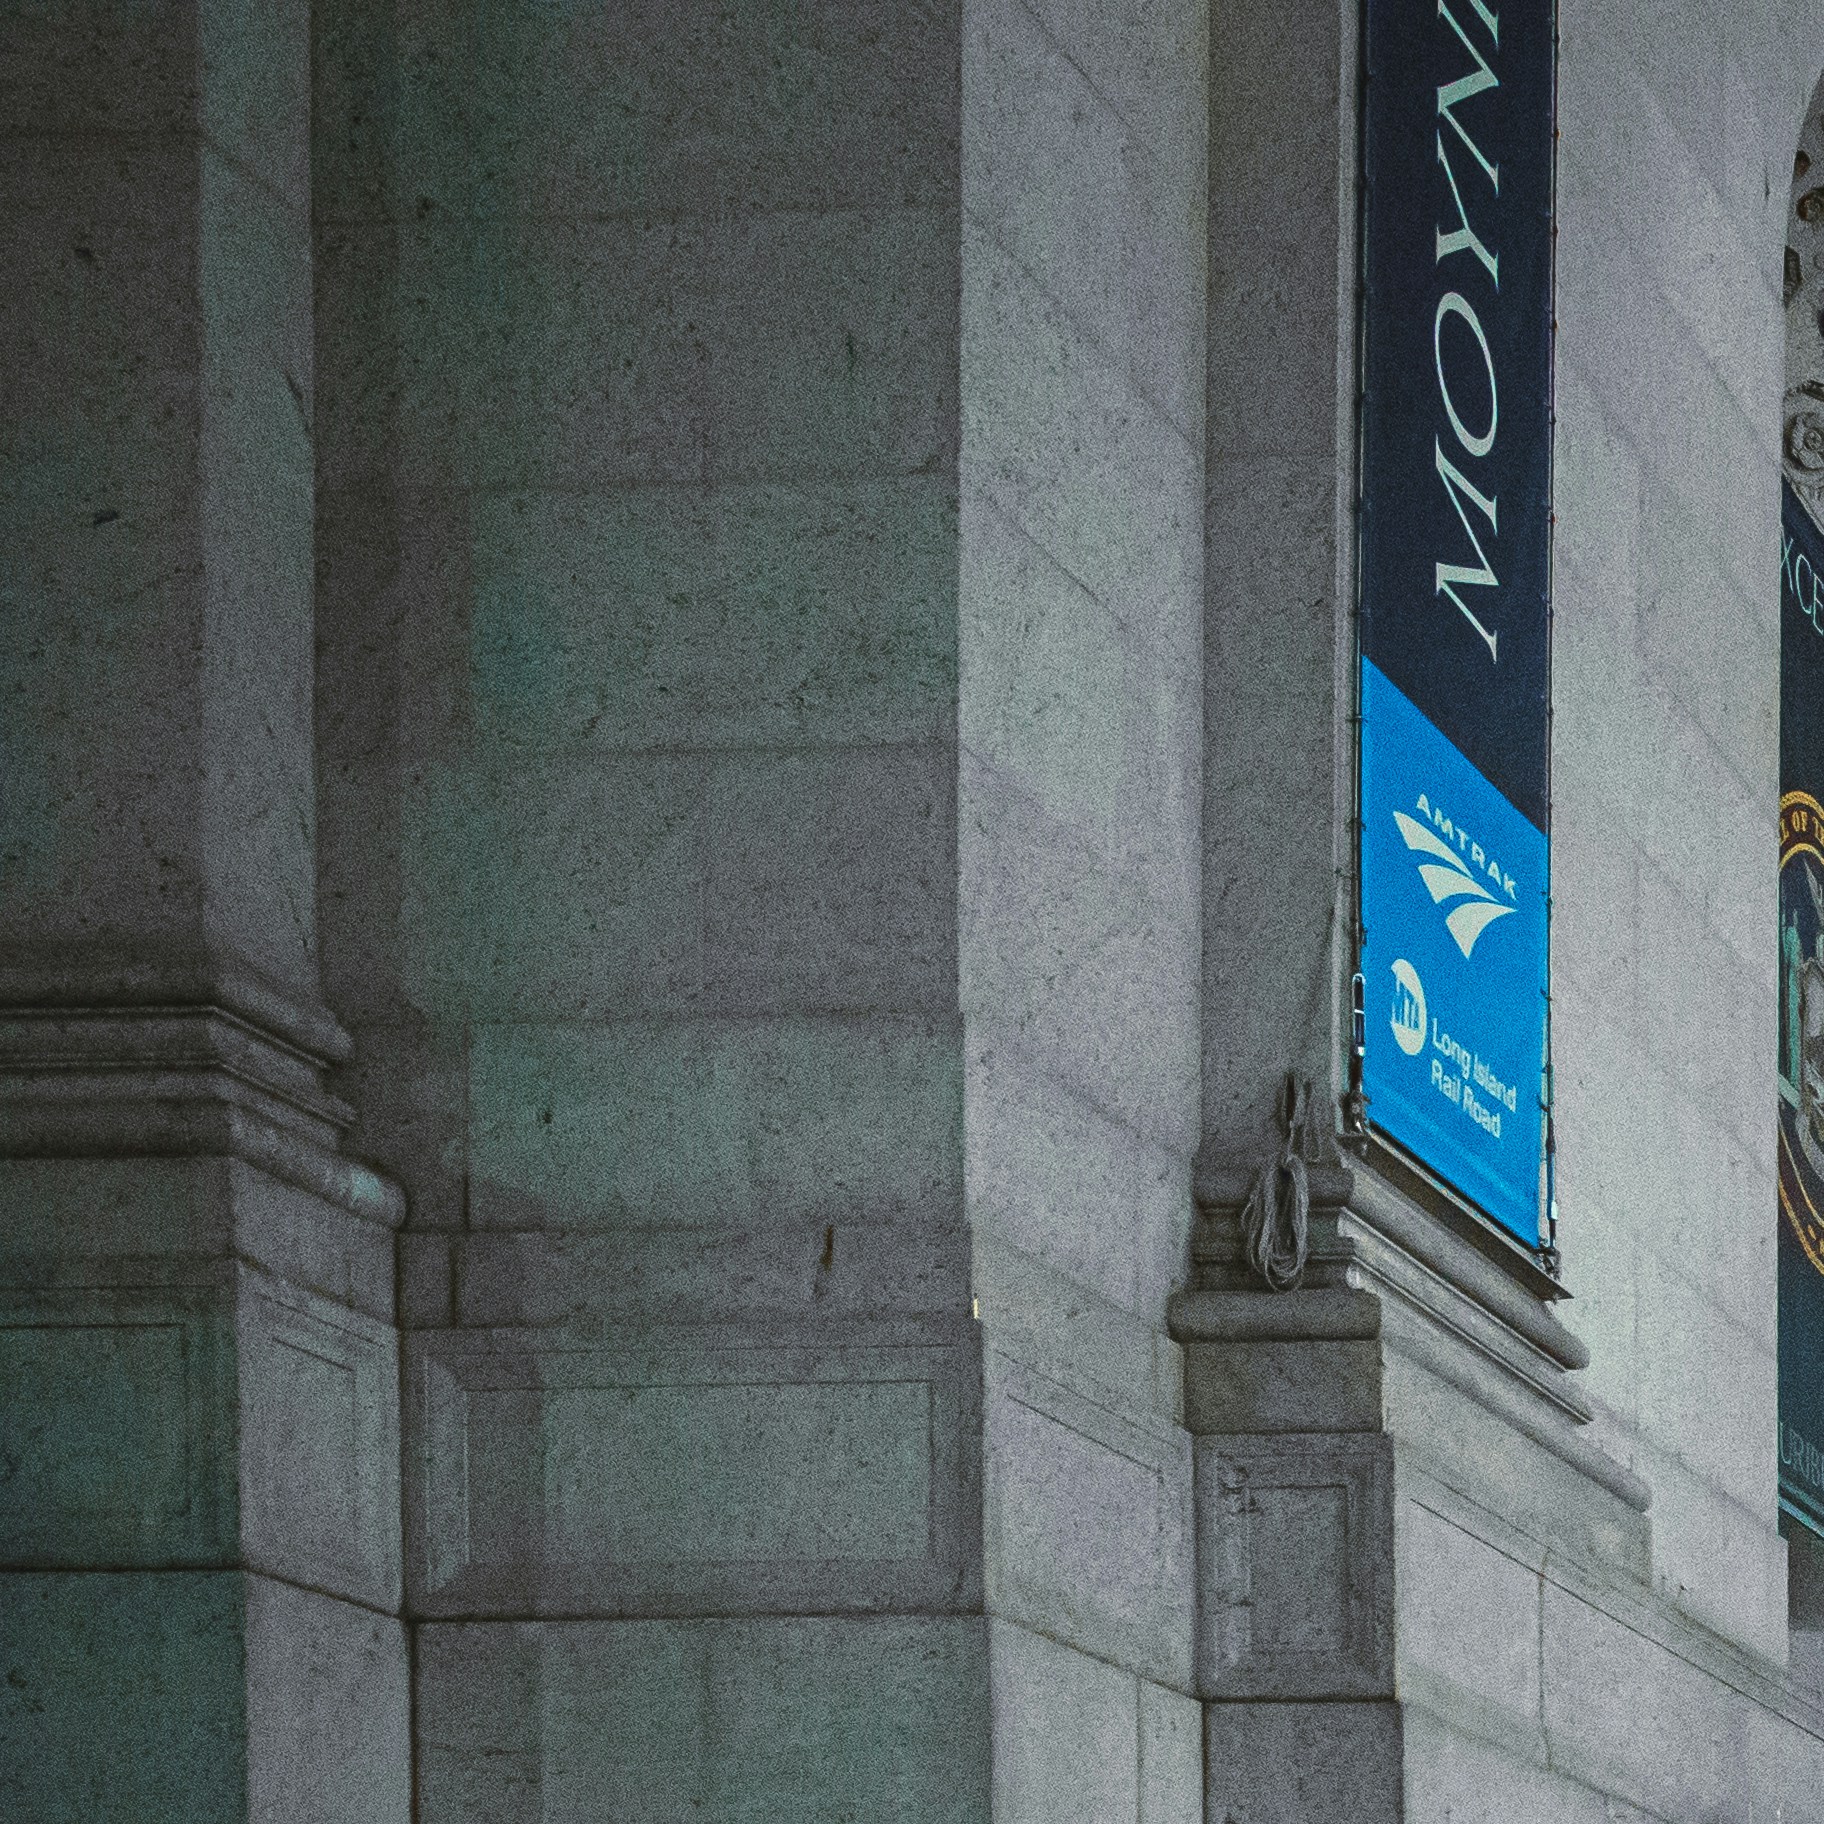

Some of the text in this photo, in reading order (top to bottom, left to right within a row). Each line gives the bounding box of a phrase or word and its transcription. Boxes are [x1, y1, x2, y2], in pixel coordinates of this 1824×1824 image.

[1416, 793, 1517, 900] AMTRAK
[1430, 1057, 1501, 1139] Rail Road
[1431, 1017, 1517, 1114] Long Island
